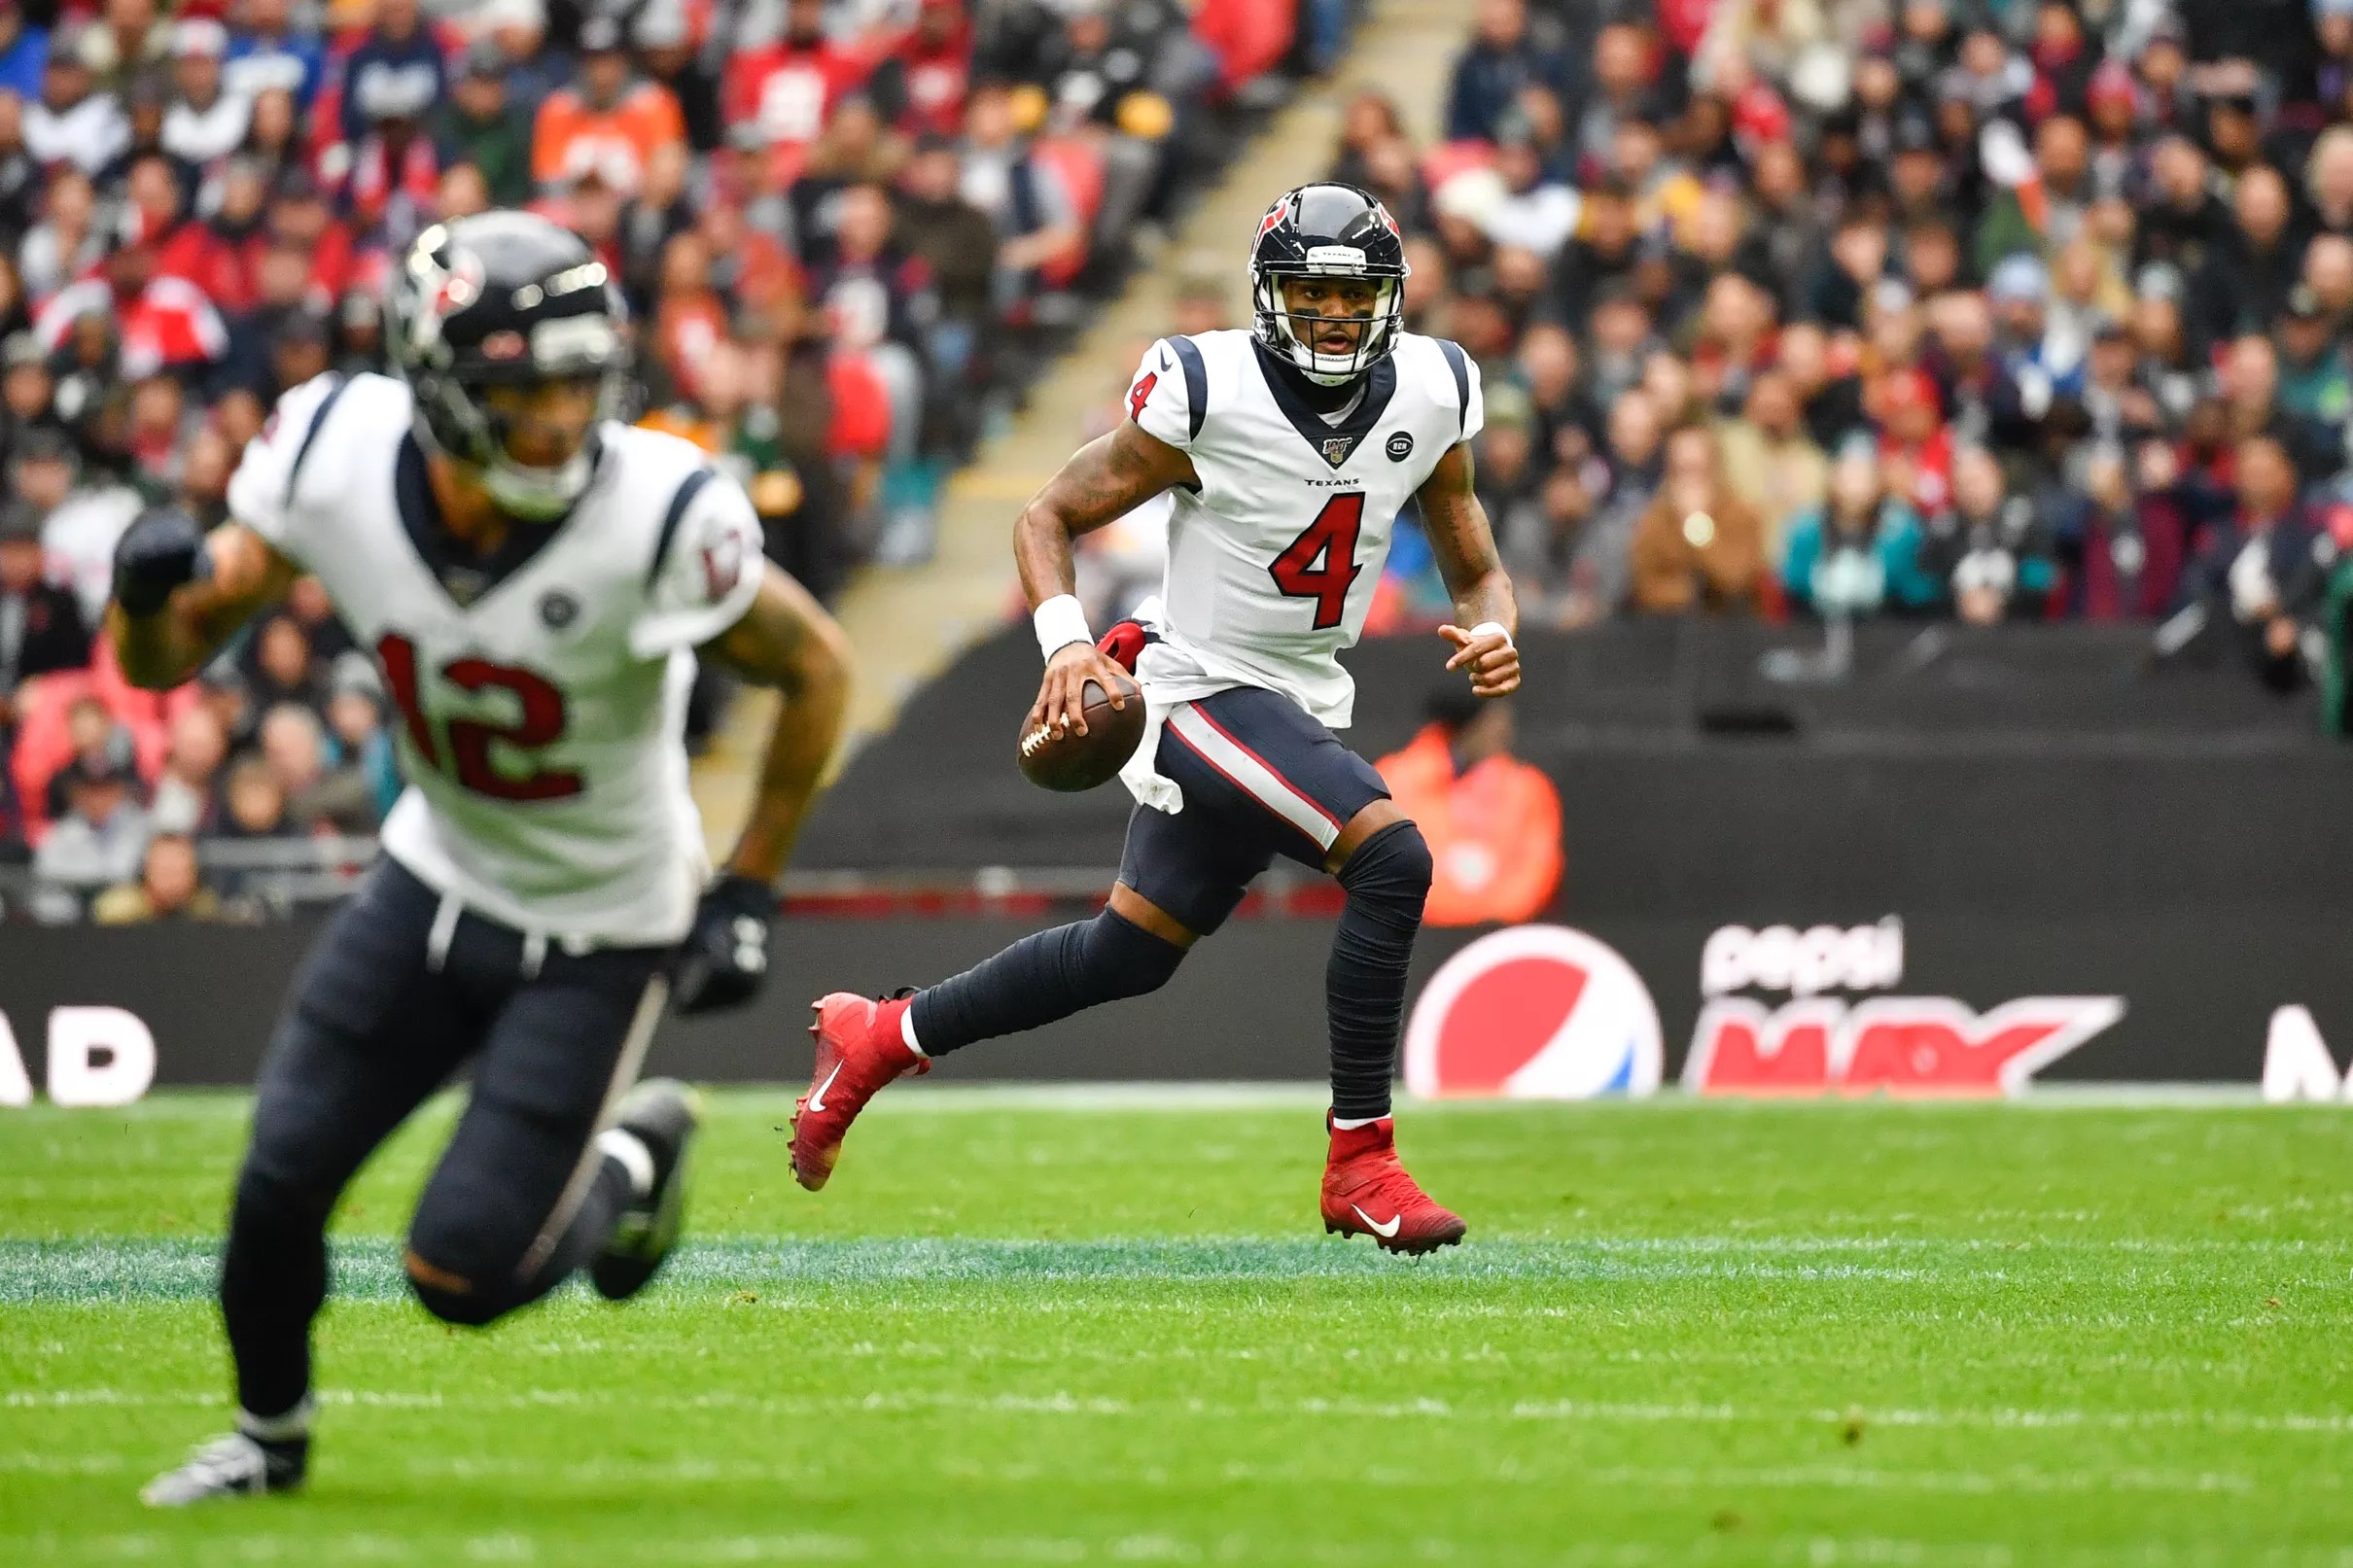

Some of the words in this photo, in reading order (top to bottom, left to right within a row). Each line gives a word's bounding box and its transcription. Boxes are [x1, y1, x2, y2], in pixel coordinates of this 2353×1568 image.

[1131, 371, 1157, 423] 4
[1304, 477, 1360, 487] TEXANS
[1267, 491, 1366, 631] 4
[375, 632, 587, 802] 12
